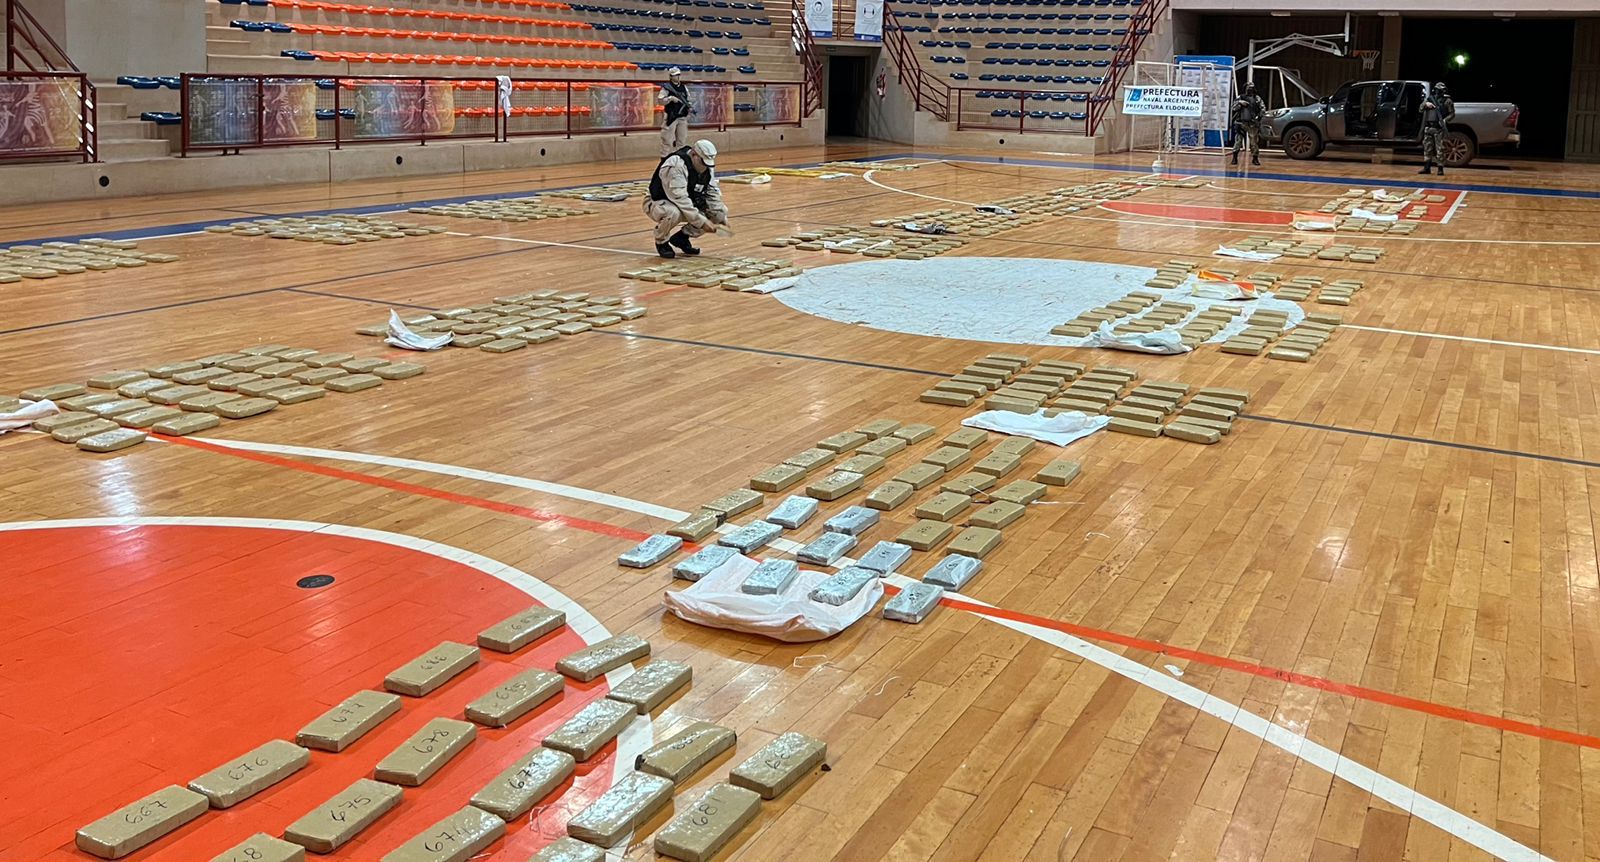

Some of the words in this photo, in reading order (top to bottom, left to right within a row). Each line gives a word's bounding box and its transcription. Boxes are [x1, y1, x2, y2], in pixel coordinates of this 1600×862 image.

[1143, 88, 1200, 97] PREFECTURA
[332, 702, 366, 723] 677
[412, 729, 450, 754] 678
[227, 755, 269, 781] 676
[125, 799, 168, 825] 667
[330, 793, 371, 822] 675
[691, 796, 722, 827] 681
